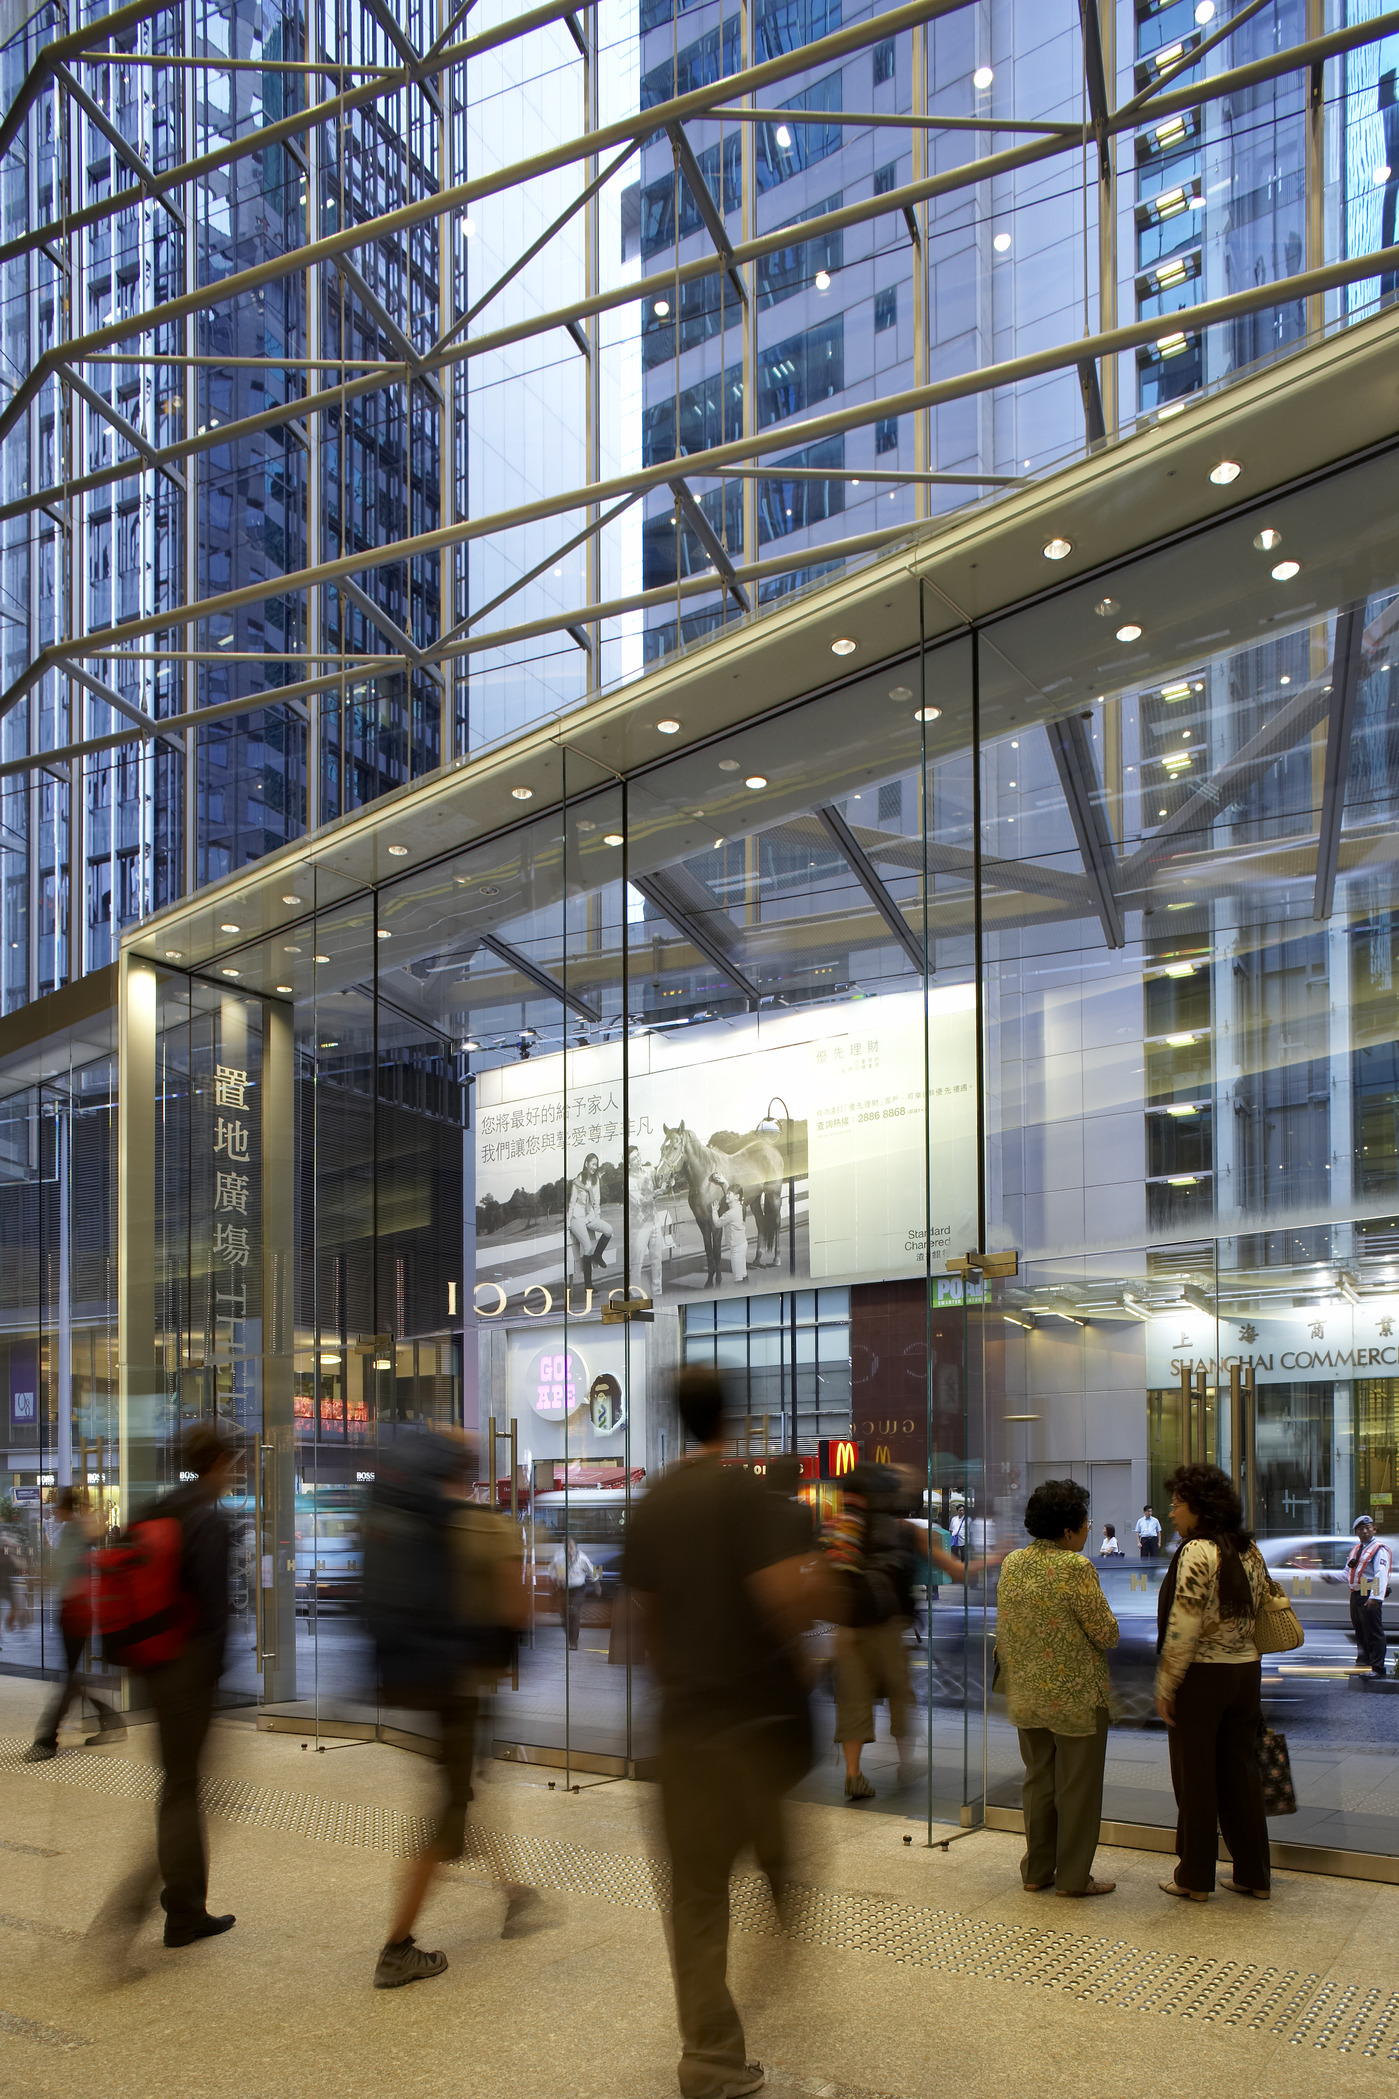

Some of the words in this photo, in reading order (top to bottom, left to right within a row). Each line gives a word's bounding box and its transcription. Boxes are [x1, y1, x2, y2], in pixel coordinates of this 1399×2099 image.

[857, 1110, 880, 1123] 2886
[882, 1106, 906, 1119] 8868
[904, 1237, 951, 1251] Charered
[540, 1354, 573, 1382] GO!
[1170, 1353, 1274, 1377] SHANGHAI
[536, 1383, 576, 1410] APE
[179, 1471, 199, 1479] BOSS
[356, 1471, 375, 1479] BOSS
[216, 1391, 249, 1630] LANDMAR
